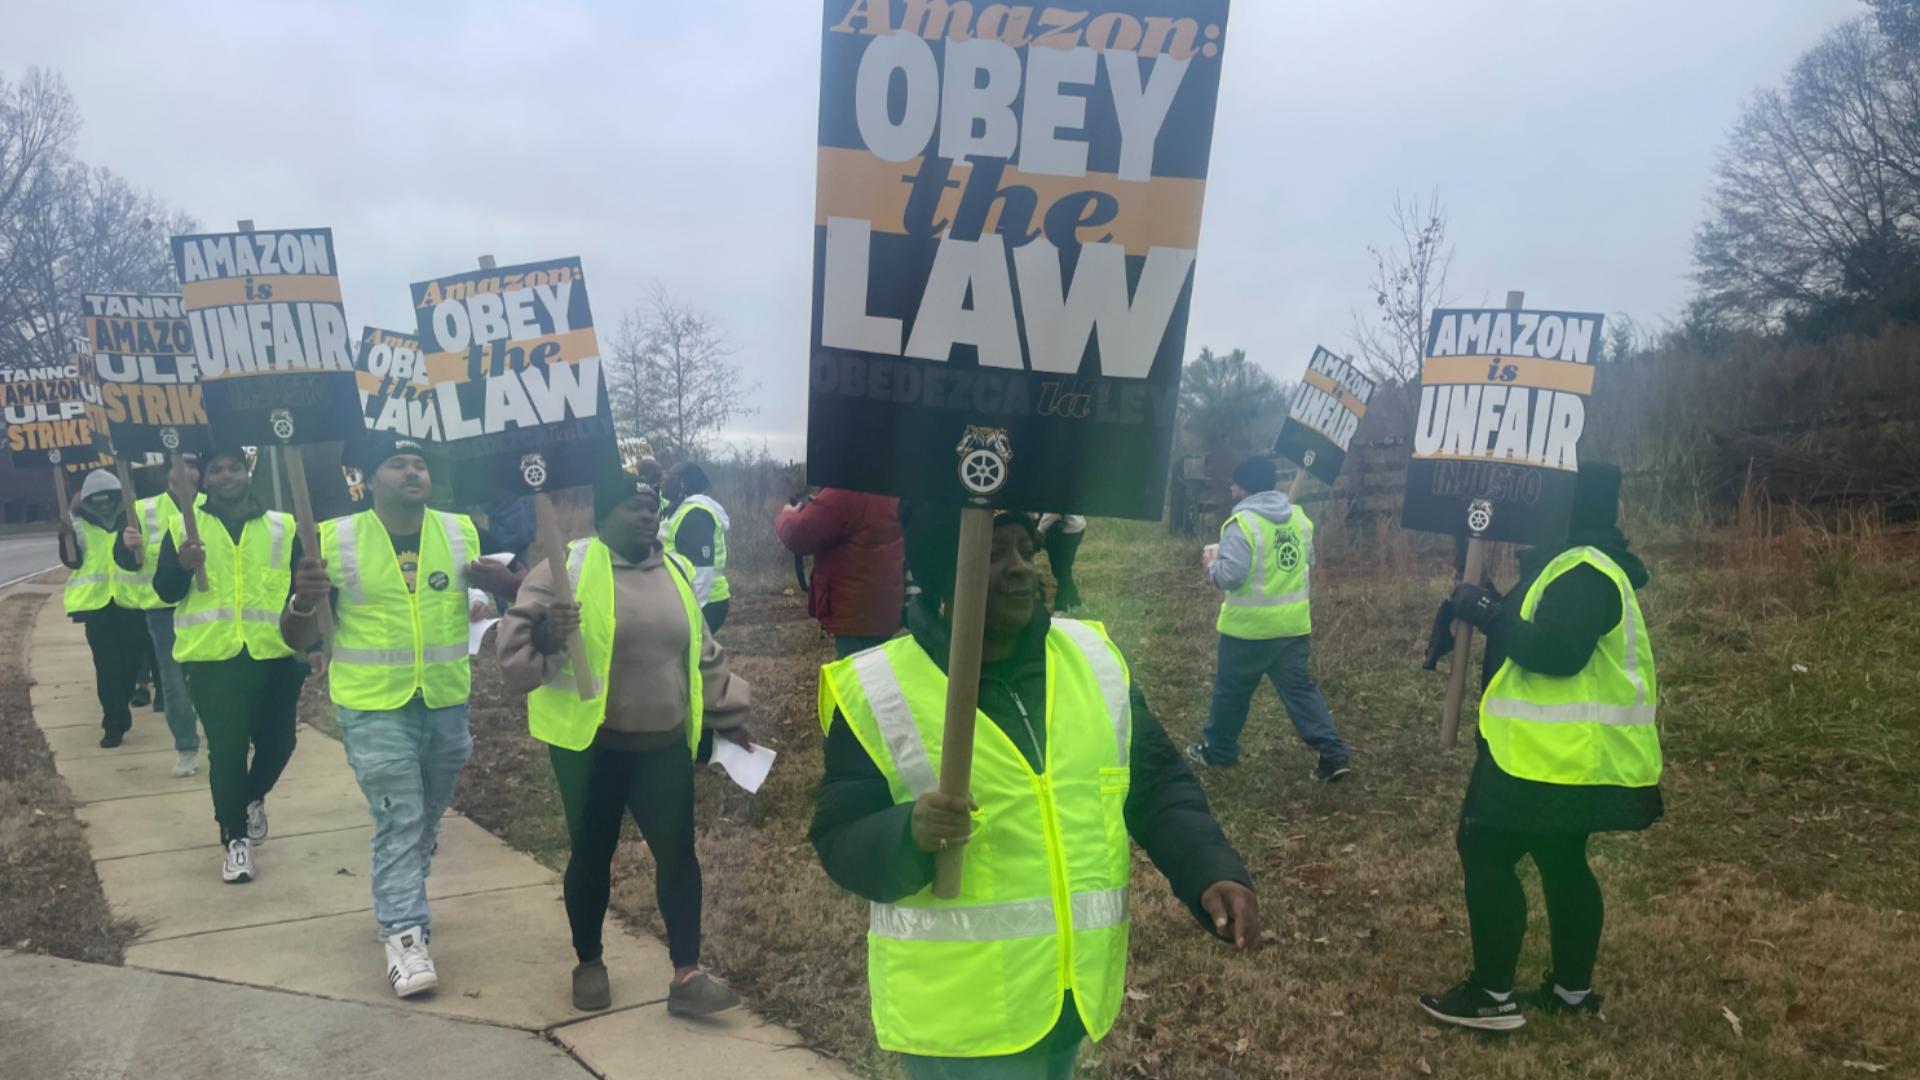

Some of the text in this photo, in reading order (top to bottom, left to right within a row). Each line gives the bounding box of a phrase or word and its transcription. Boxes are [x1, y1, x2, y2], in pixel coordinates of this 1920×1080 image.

[830, 0, 1220, 60] Amazon:
[856, 29, 1193, 181] OBEY
[902, 154, 1119, 248] the
[183, 233, 331, 283] AMAZON
[84, 295, 185, 318] TANN
[245, 276, 273, 301] is
[417, 266, 583, 309] Amazon:
[821, 216, 1196, 379] LAW
[96, 318, 193, 354] AMAZO
[188, 303, 354, 378] UNFAIR
[432, 281, 573, 352] OBEY
[1432, 312, 1594, 364] AMAZON
[463, 338, 561, 376] the
[1310, 349, 1374, 406] AMAZON
[1487, 358, 1519, 382] is
[101, 382, 208, 426] STRIK
[435, 356, 600, 442] LAW
[812, 352, 1030, 417] OBEDEZCA
[4, 401, 86, 425] ULP
[7, 418, 93, 451] STRIKE
[1289, 380, 1359, 453] UNFAIR
[1414, 384, 1585, 472] UNFAIR
